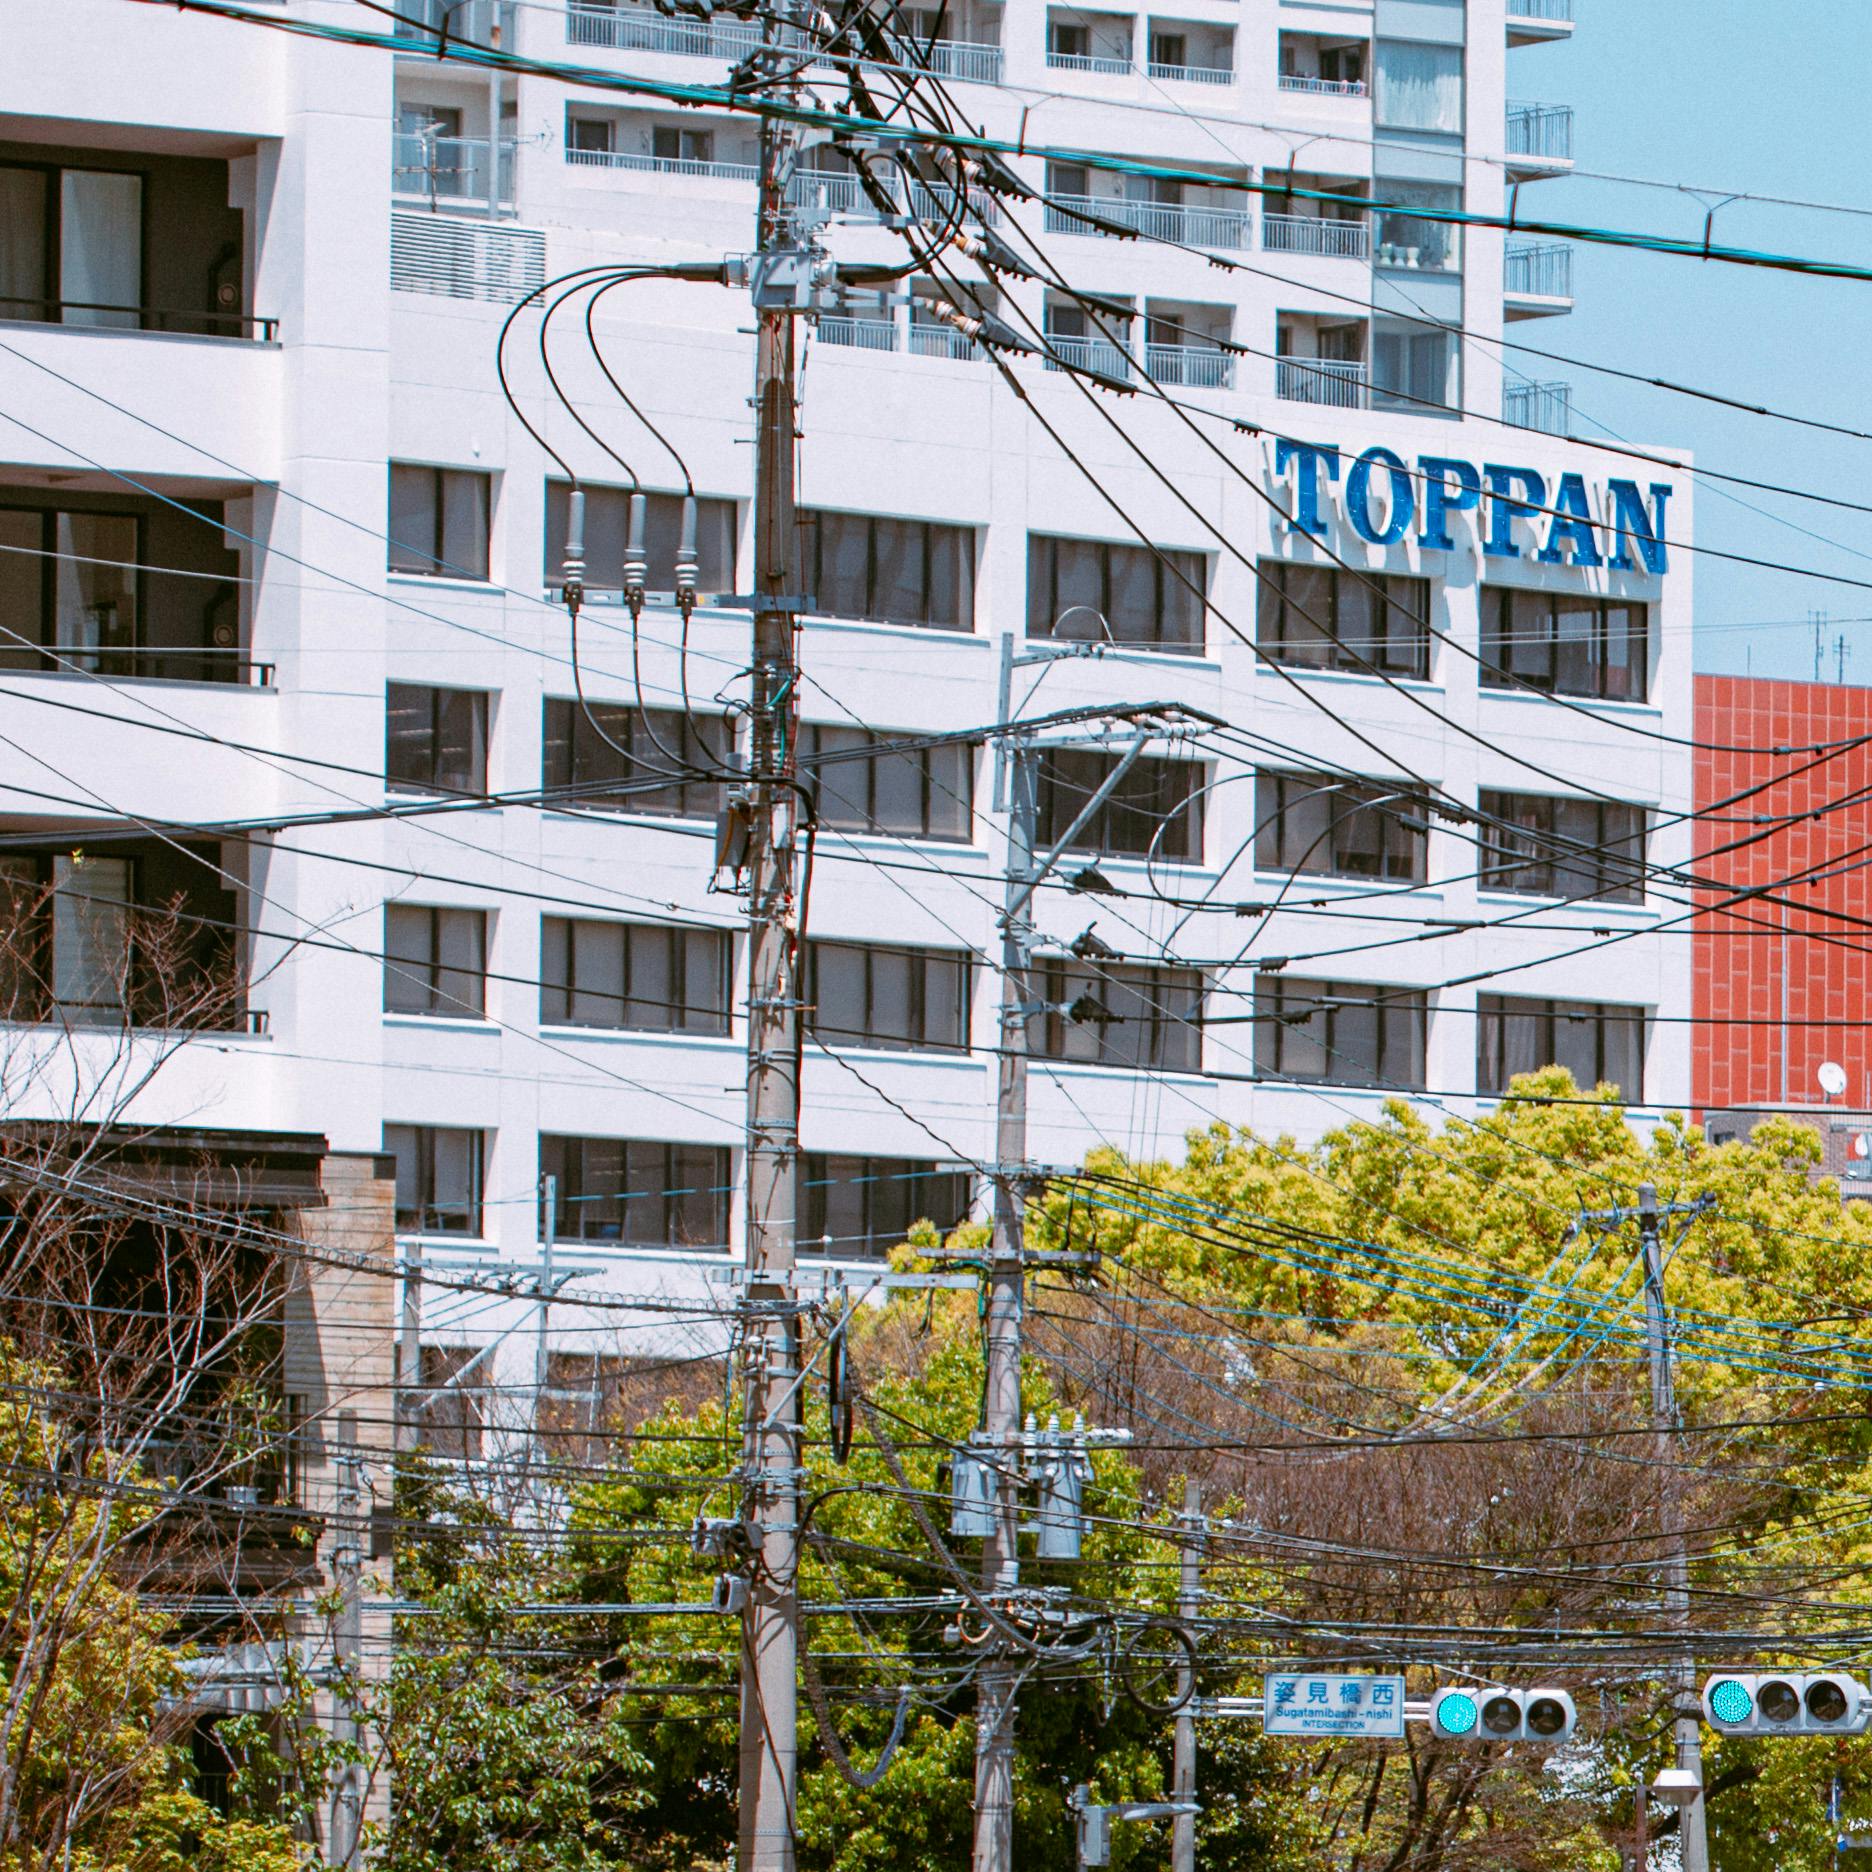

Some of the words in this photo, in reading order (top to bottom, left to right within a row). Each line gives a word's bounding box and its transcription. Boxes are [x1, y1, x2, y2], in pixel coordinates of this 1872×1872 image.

[1274, 438, 1673, 574] TOPPAN
[1274, 1681, 1395, 1705] 姿見橋西
[1302, 1720, 1366, 1730] INTERSECTION
